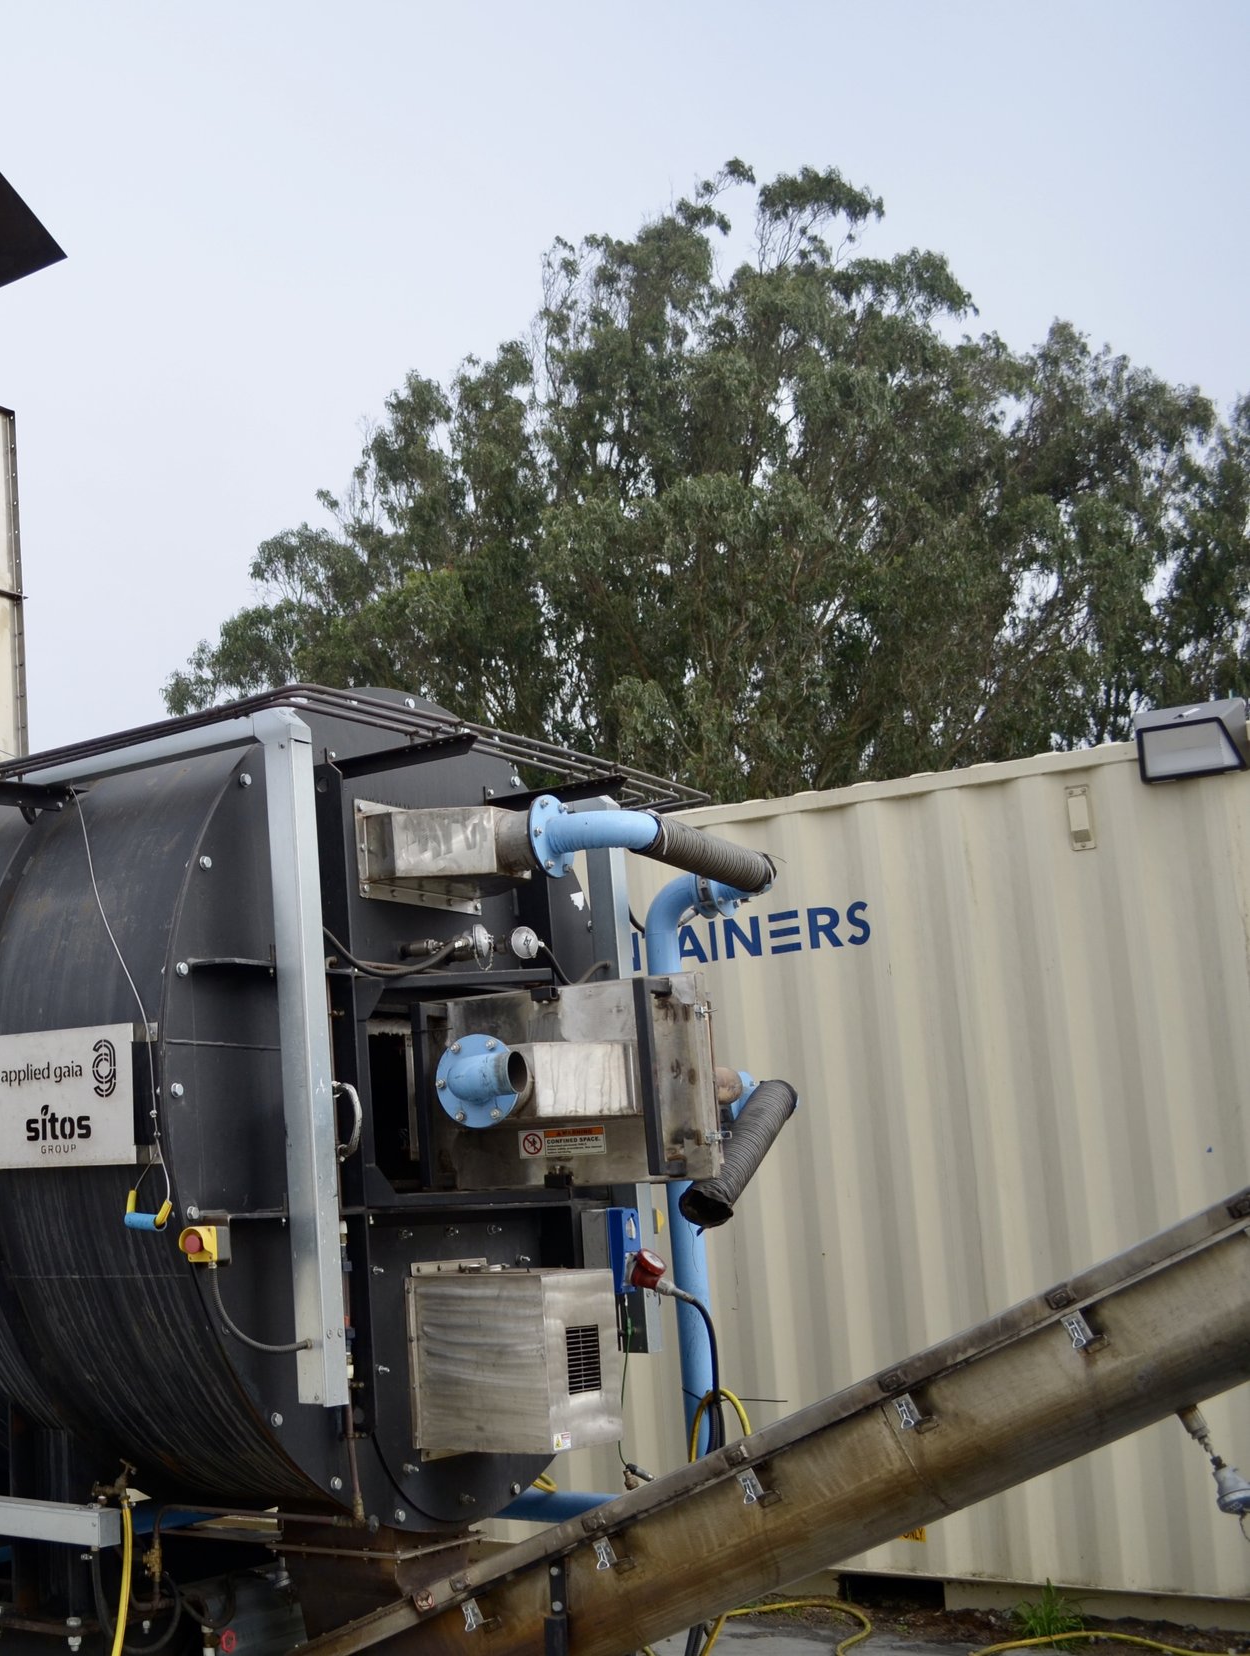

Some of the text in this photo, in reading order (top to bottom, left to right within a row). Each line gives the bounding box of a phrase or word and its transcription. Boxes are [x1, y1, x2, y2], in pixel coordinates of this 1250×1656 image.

[632, 901, 870, 971] AINERS
[1, 1061, 83, 1086] applied gaia
[26, 1104, 92, 1141] sitos
[41, 1144, 77, 1154] GROUP
